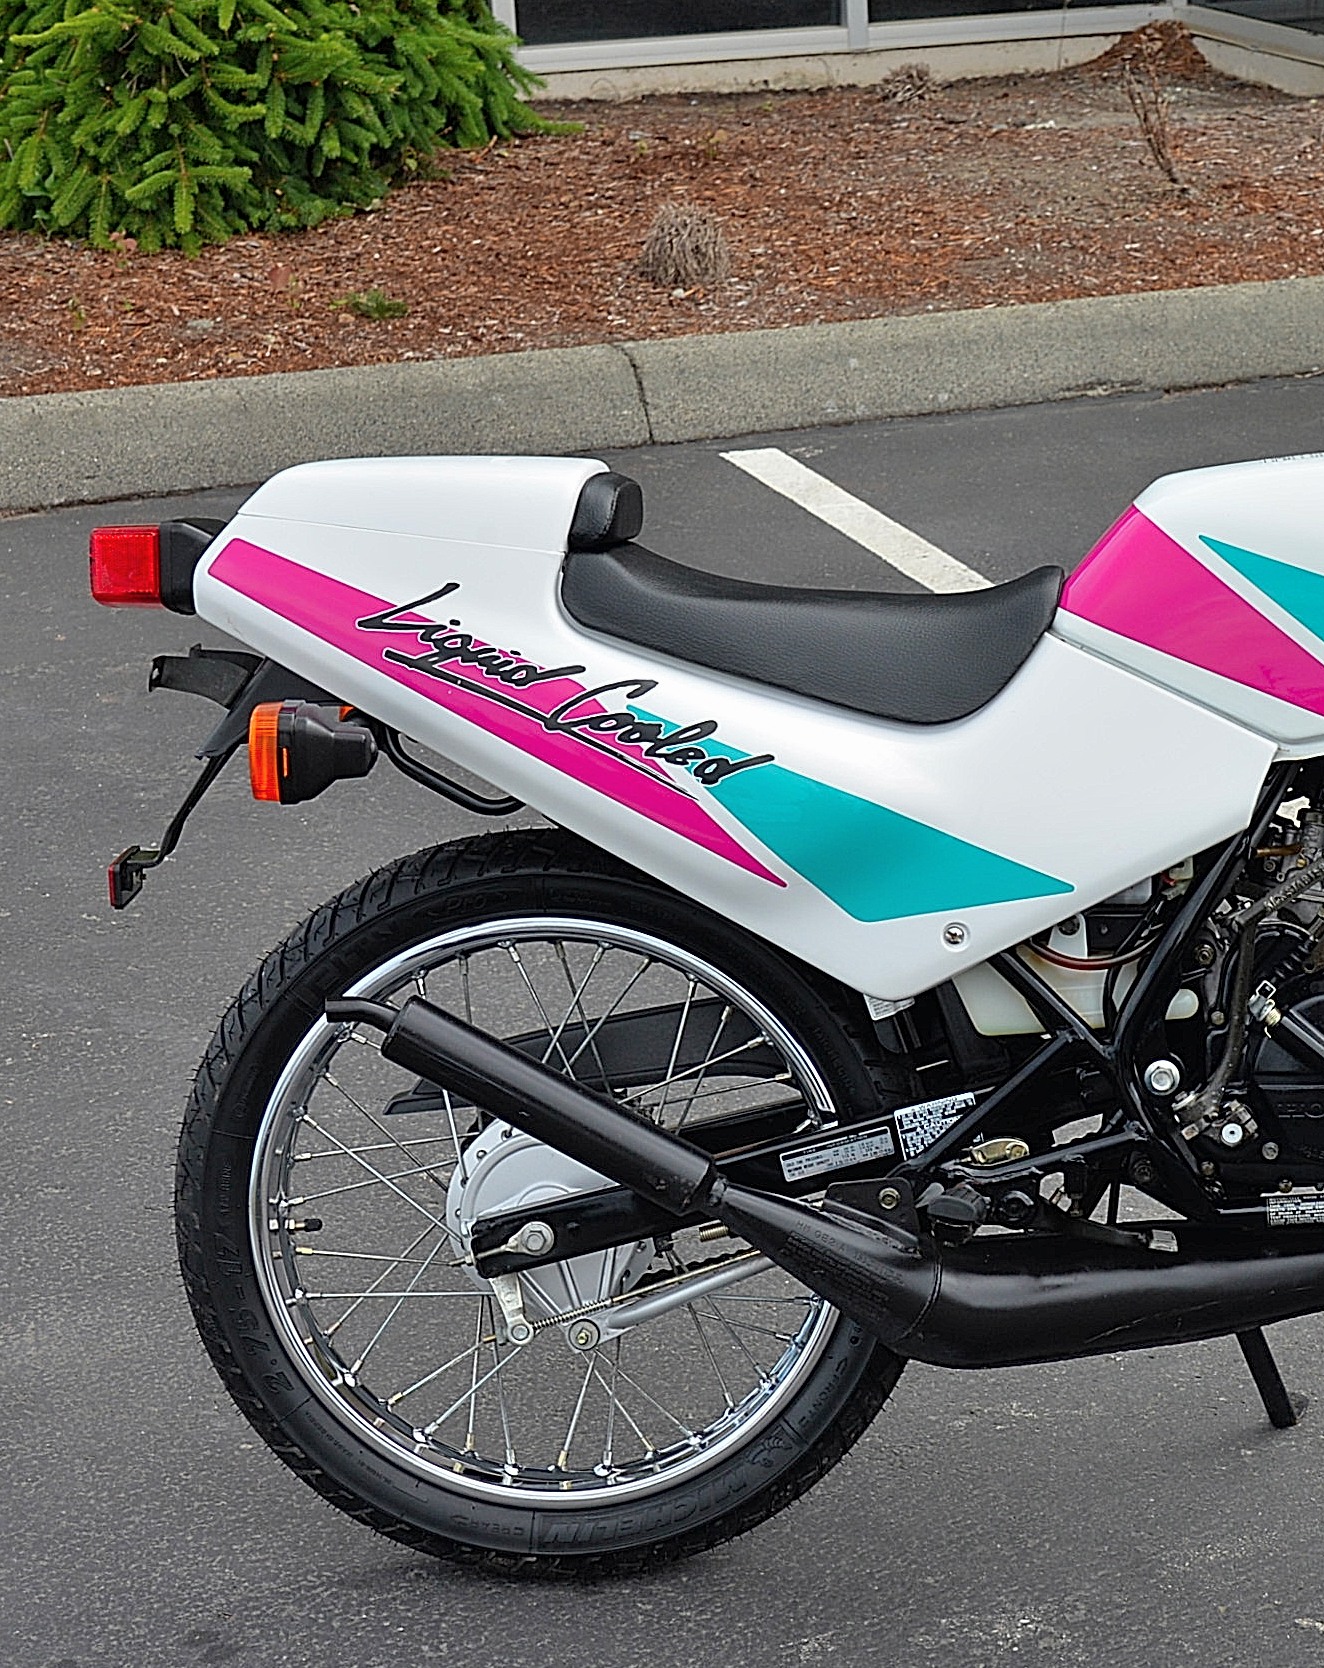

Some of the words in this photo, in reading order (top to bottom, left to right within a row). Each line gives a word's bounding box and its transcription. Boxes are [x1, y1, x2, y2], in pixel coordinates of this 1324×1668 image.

[357, 582, 586, 688] Liquid
[546, 679, 775, 785] Cooled
[541, 1465, 746, 1543] MICHELIN
